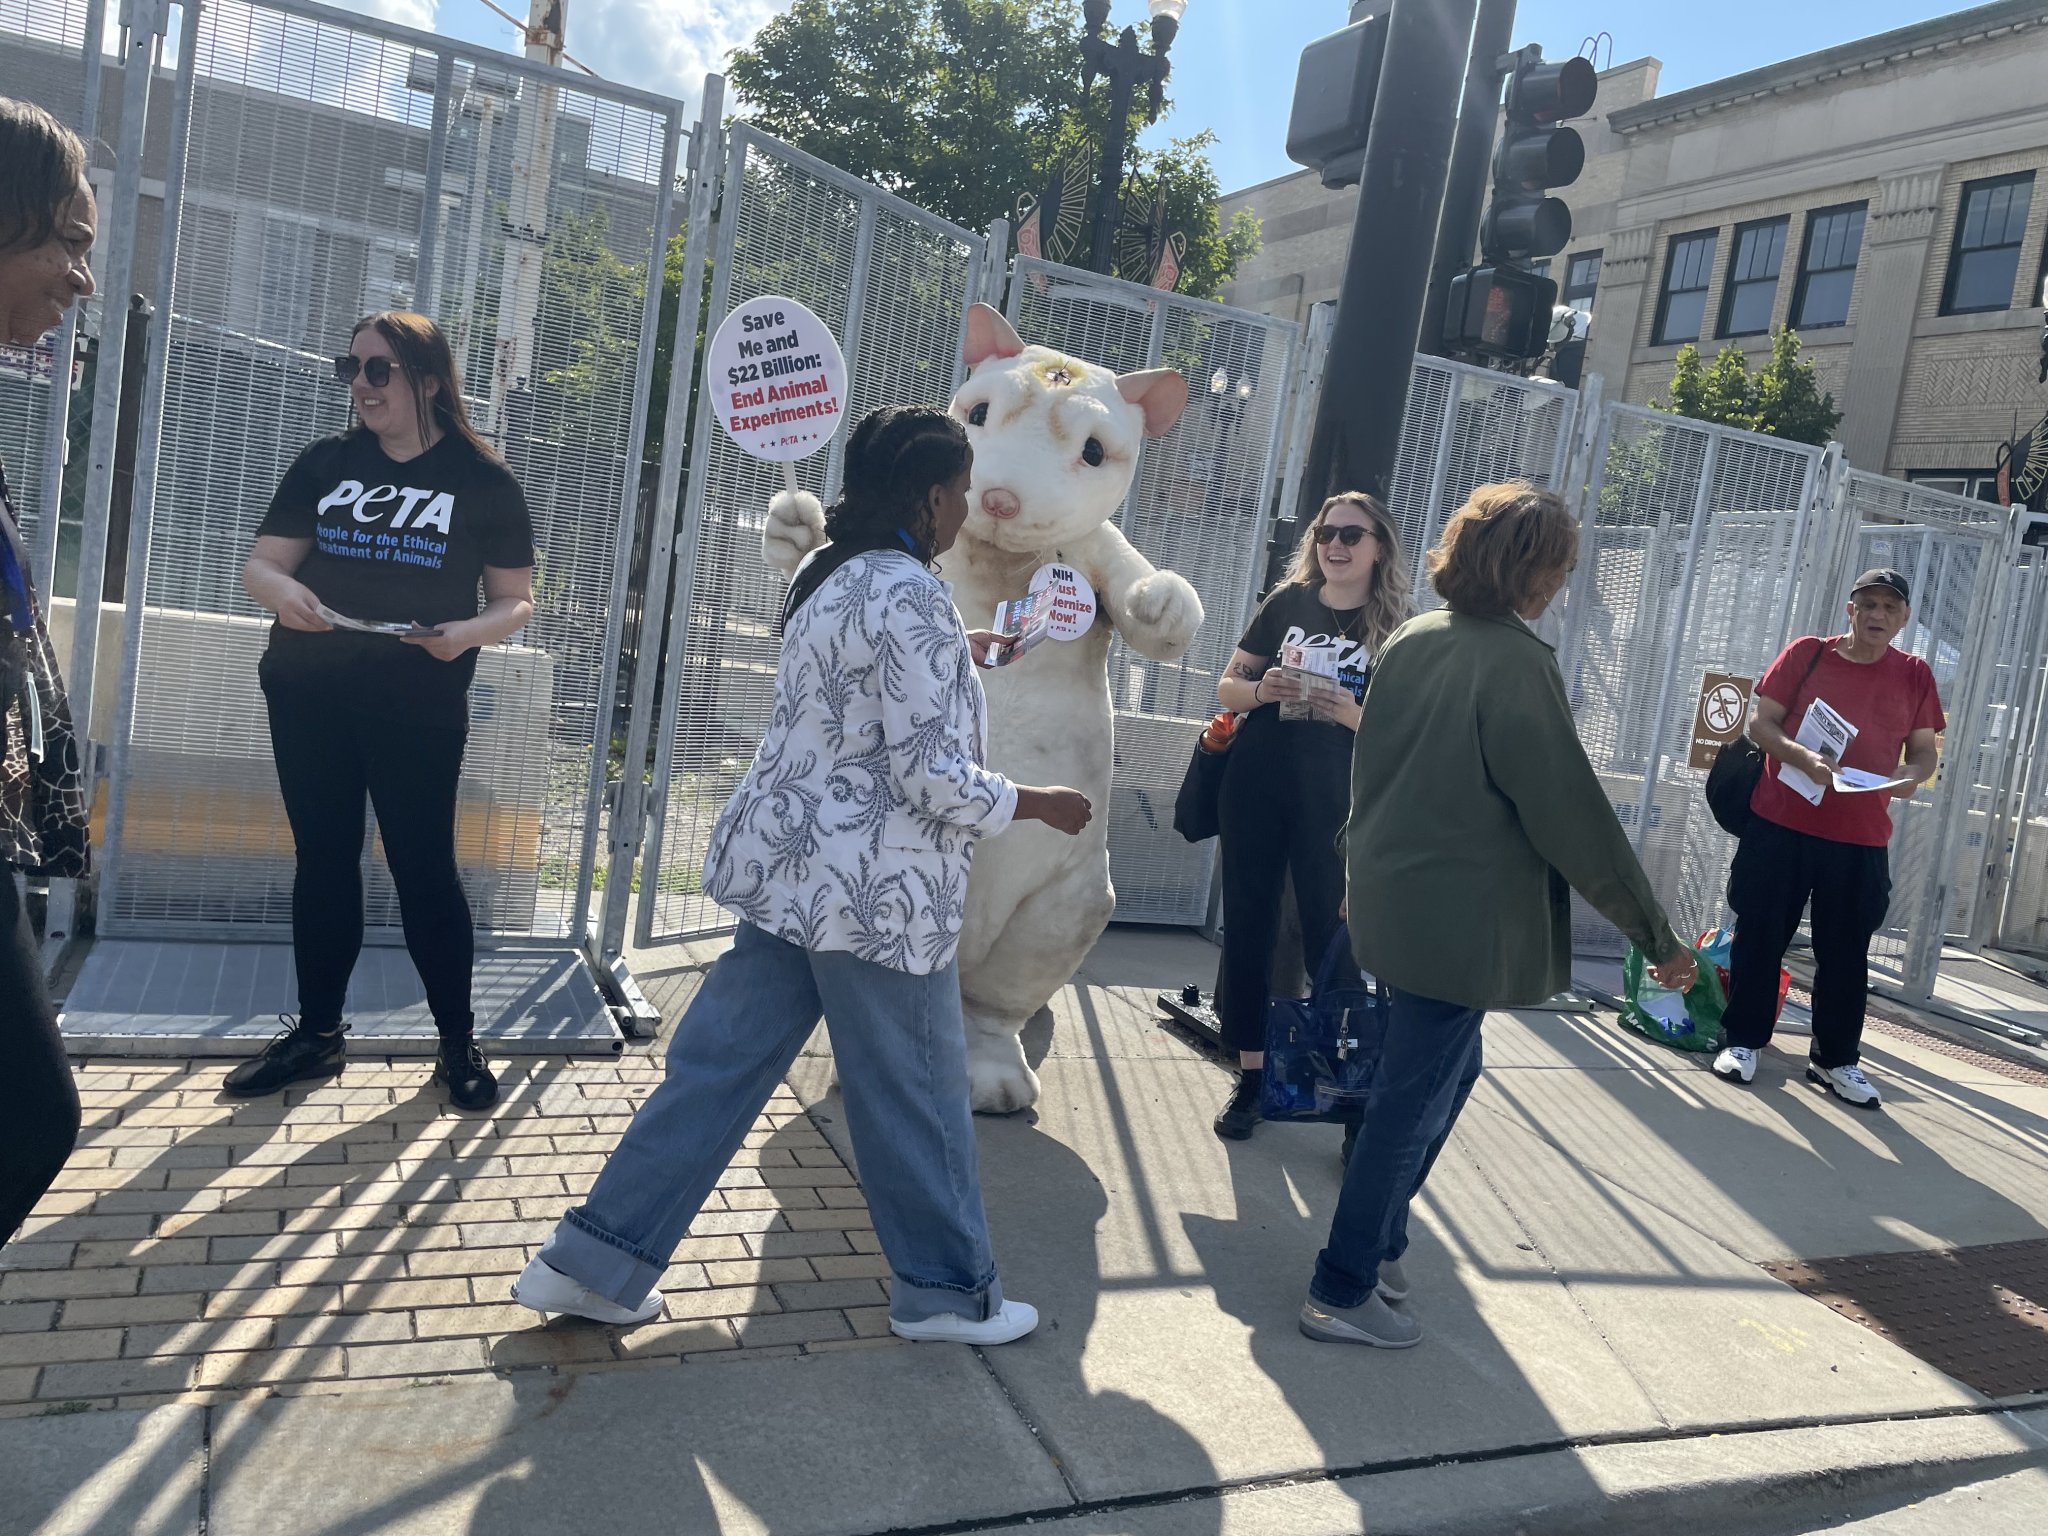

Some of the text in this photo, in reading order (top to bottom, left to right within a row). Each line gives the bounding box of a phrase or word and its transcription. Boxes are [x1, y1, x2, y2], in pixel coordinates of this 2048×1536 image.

[742, 311, 785, 332] Save
[738, 330, 799, 359] Me and
[728, 353, 822, 387] $22 Billion:
[731, 374, 828, 409] End Animal
[730, 397, 839, 432] Experiments!
[353, 529, 373, 543] for
[376, 533, 399, 547] the
[403, 534, 447, 555] Ethical
[375, 547, 390, 561] of
[393, 549, 443, 569] Animals
[1052, 568, 1073, 582] NIH
[1053, 583, 1077, 597] ust
[1049, 609, 1077, 624] Now!
